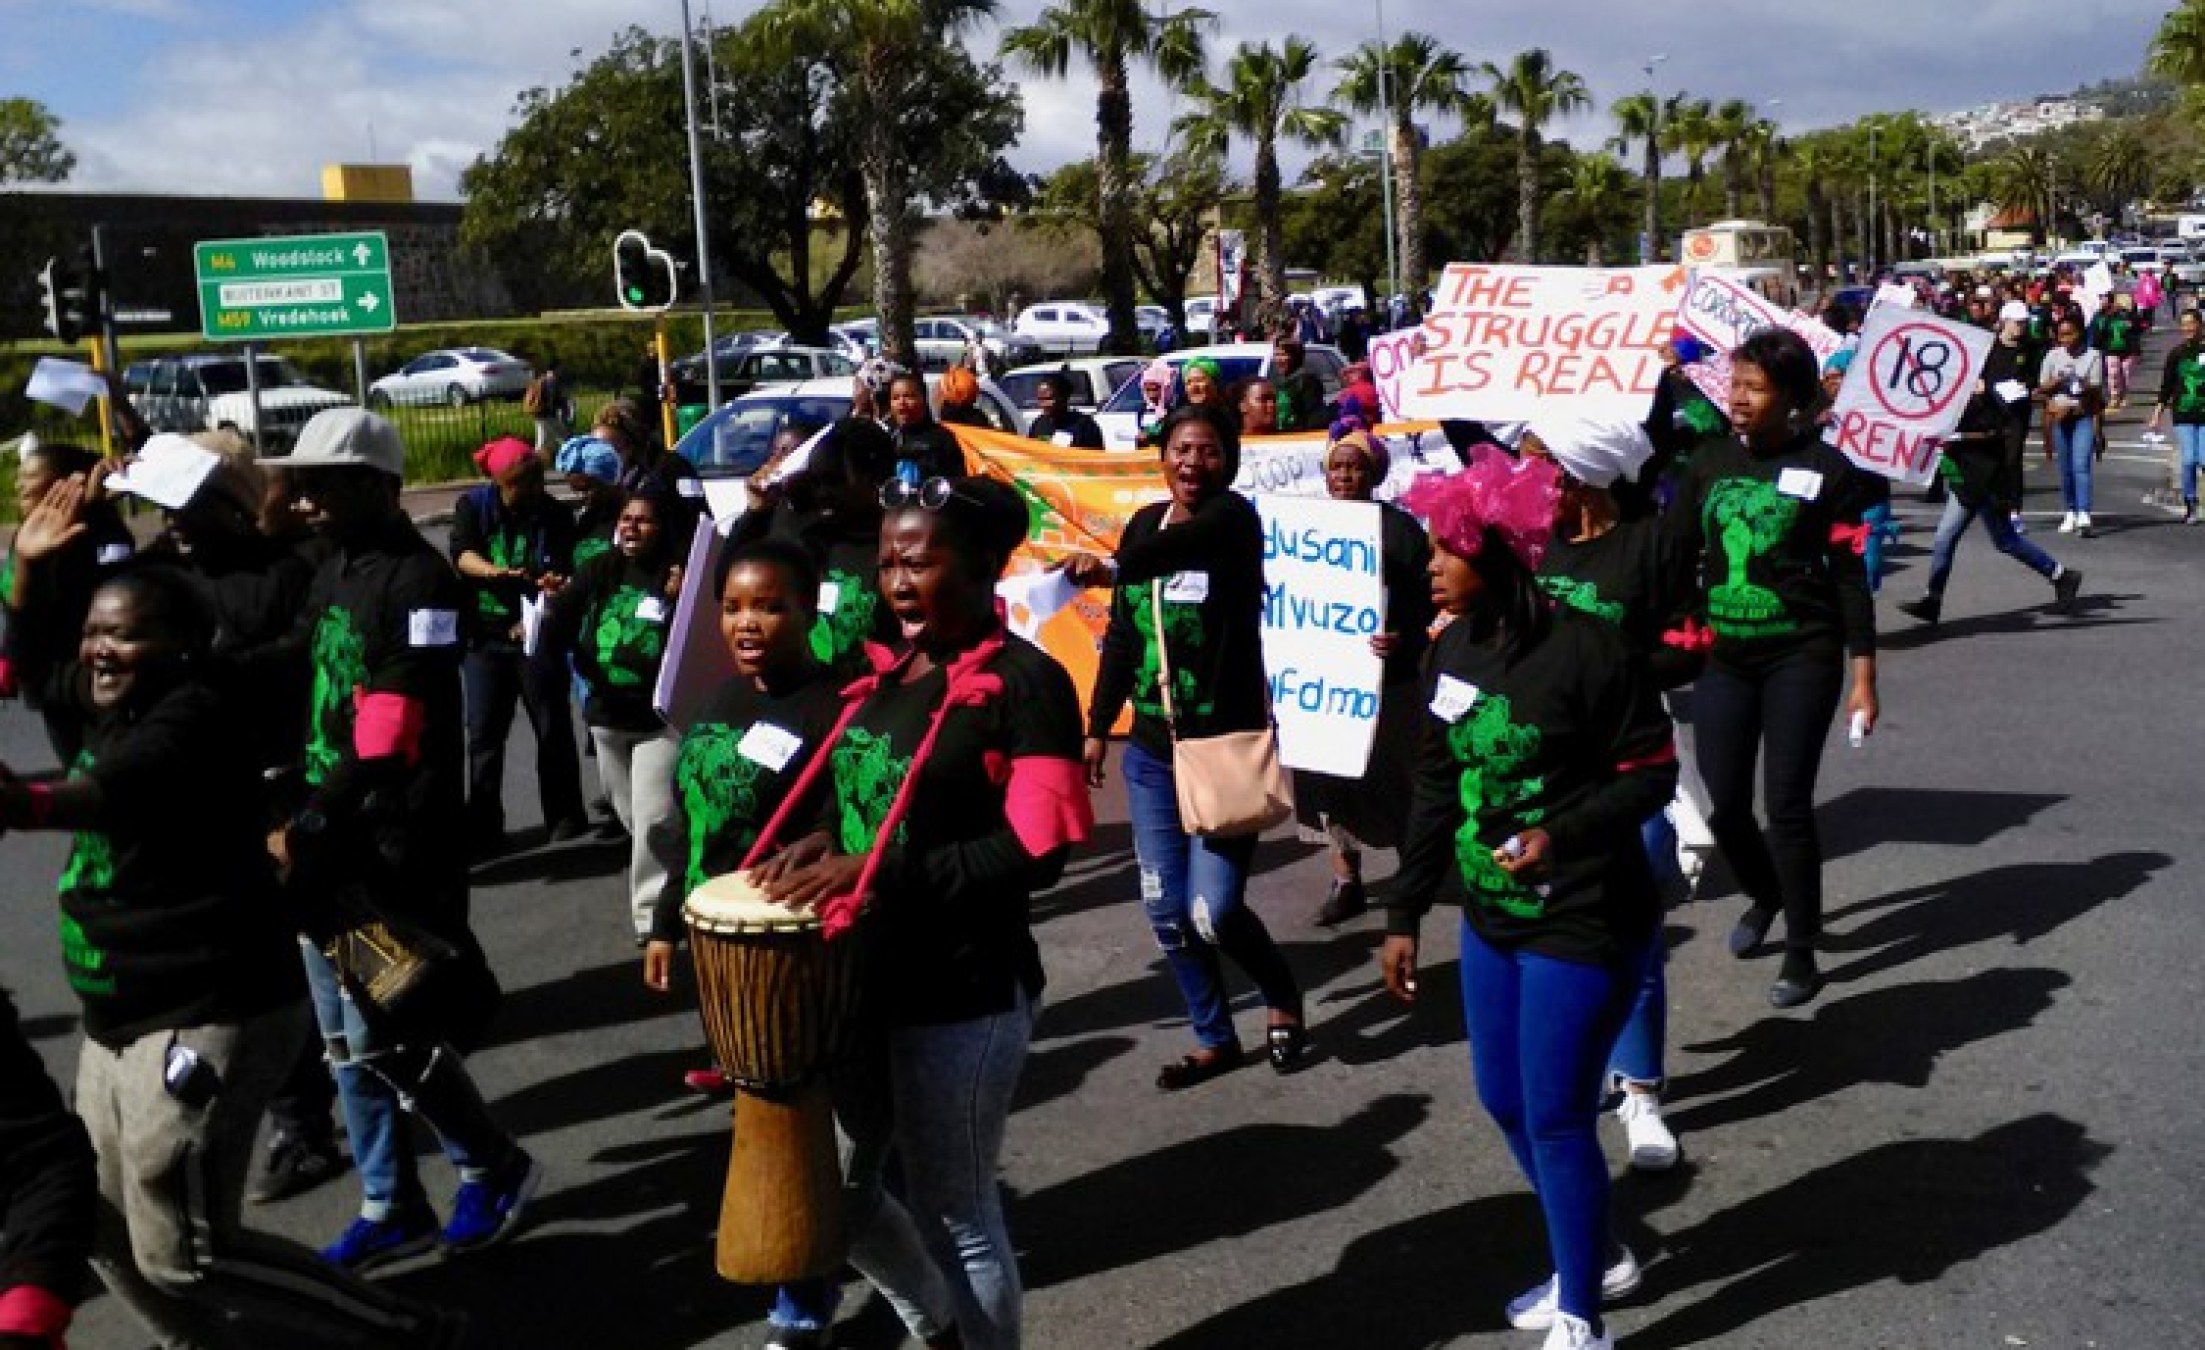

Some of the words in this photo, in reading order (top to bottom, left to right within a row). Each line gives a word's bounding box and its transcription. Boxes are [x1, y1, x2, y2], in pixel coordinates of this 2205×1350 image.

[252, 247, 345, 268] Woodstock
[320, 282, 337, 297] ST
[1447, 267, 1540, 307] THE
[258, 306, 351, 328] Vredehoek
[1424, 311, 1680, 352] STRUGGLE
[1416, 352, 1493, 396] IS
[1513, 350, 1657, 397] REAL
[1835, 410, 1945, 474] RENT
